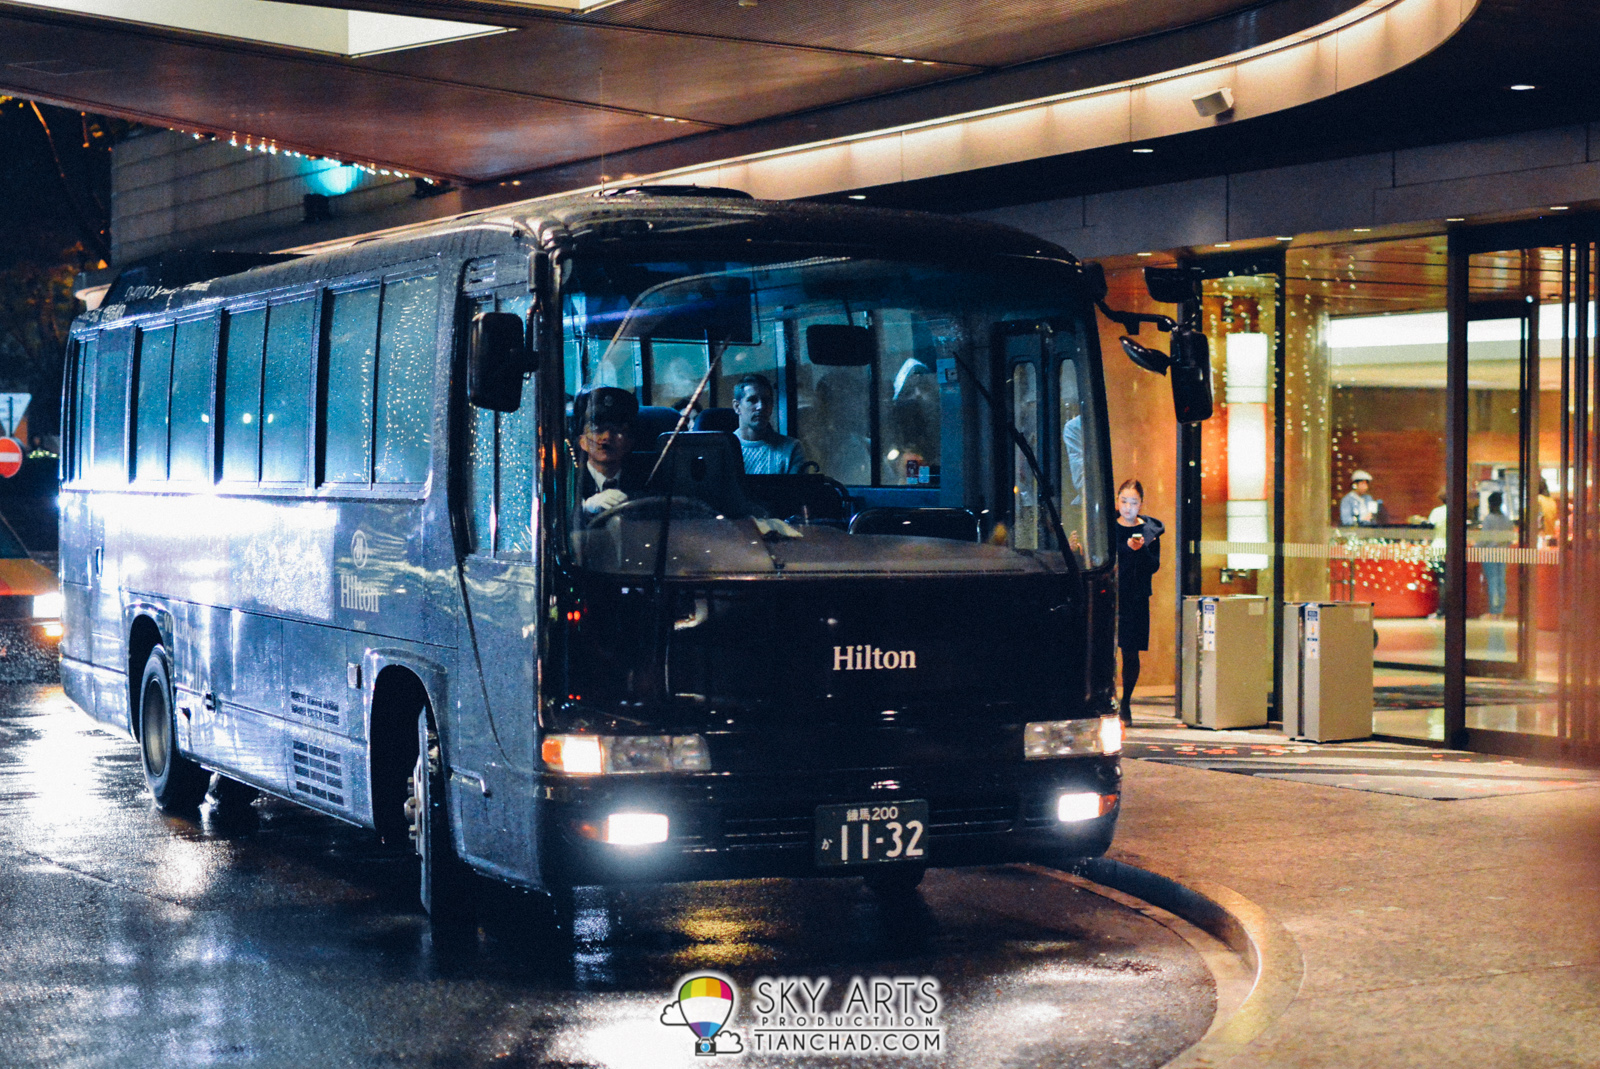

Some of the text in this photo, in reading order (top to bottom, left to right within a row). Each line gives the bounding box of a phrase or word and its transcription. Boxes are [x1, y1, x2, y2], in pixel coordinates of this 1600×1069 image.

[341, 574, 380, 613] Hilton
[833, 644, 917, 671] Hilton
[841, 820, 924, 861] 11-32
